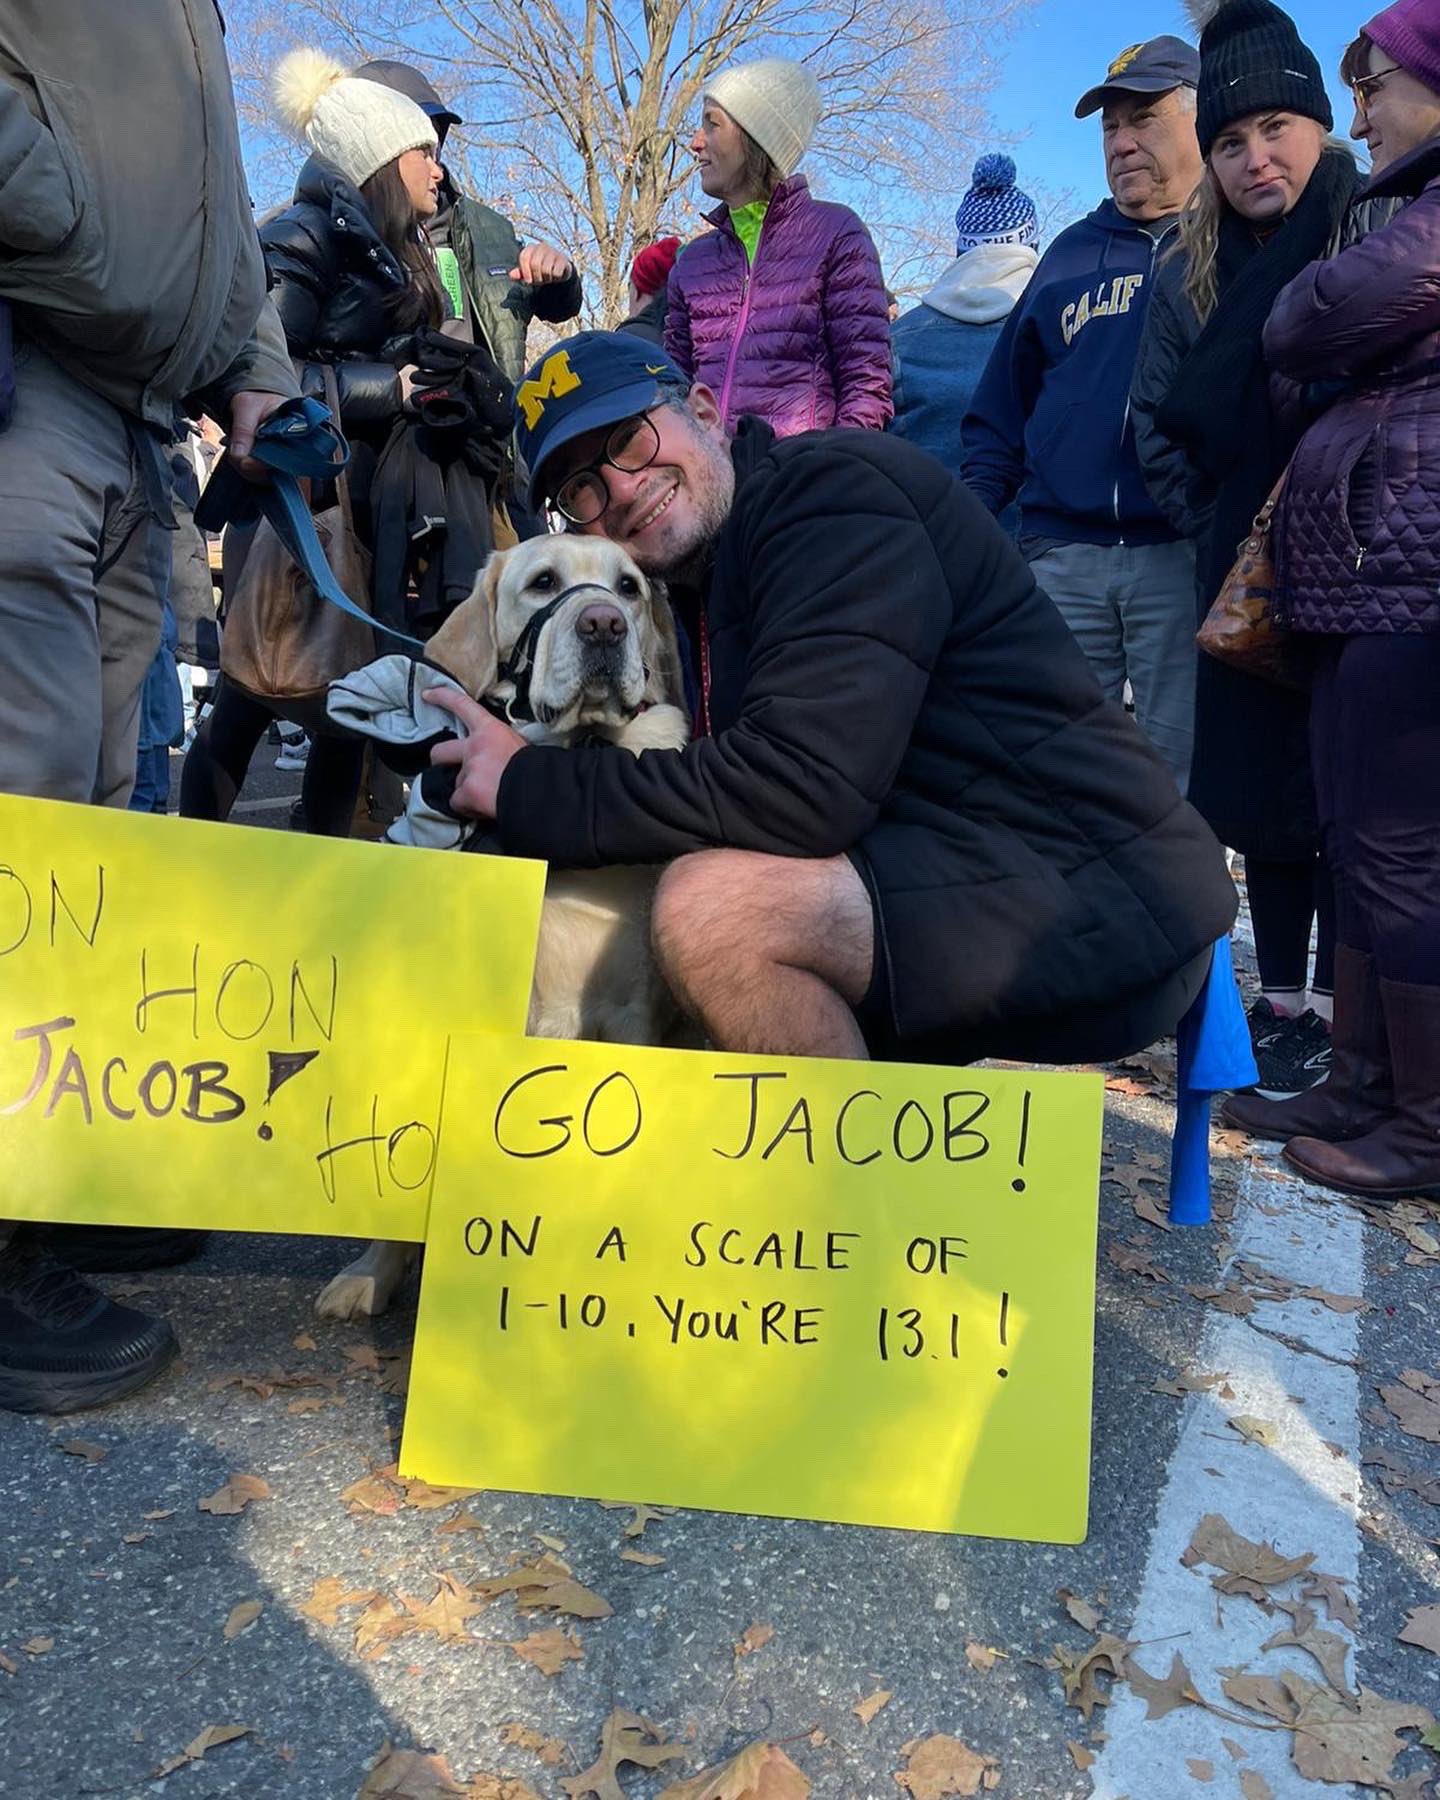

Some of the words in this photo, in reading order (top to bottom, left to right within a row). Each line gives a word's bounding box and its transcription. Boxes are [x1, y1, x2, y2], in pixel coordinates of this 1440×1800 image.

[1060, 273, 1144, 346] CALIF
[516, 350, 582, 431] M
[136, 943, 338, 1041] HON
[0, 1016, 320, 1141] JACOB!
[316, 1094, 436, 1204] HO
[494, 1065, 642, 1158] GO
[712, 1072, 1032, 1193] JACOB!
[464, 1215, 542, 1257] ON
[595, 1226, 629, 1262] A
[685, 1222, 861, 1270] SCALE
[906, 1236, 969, 1275] OF
